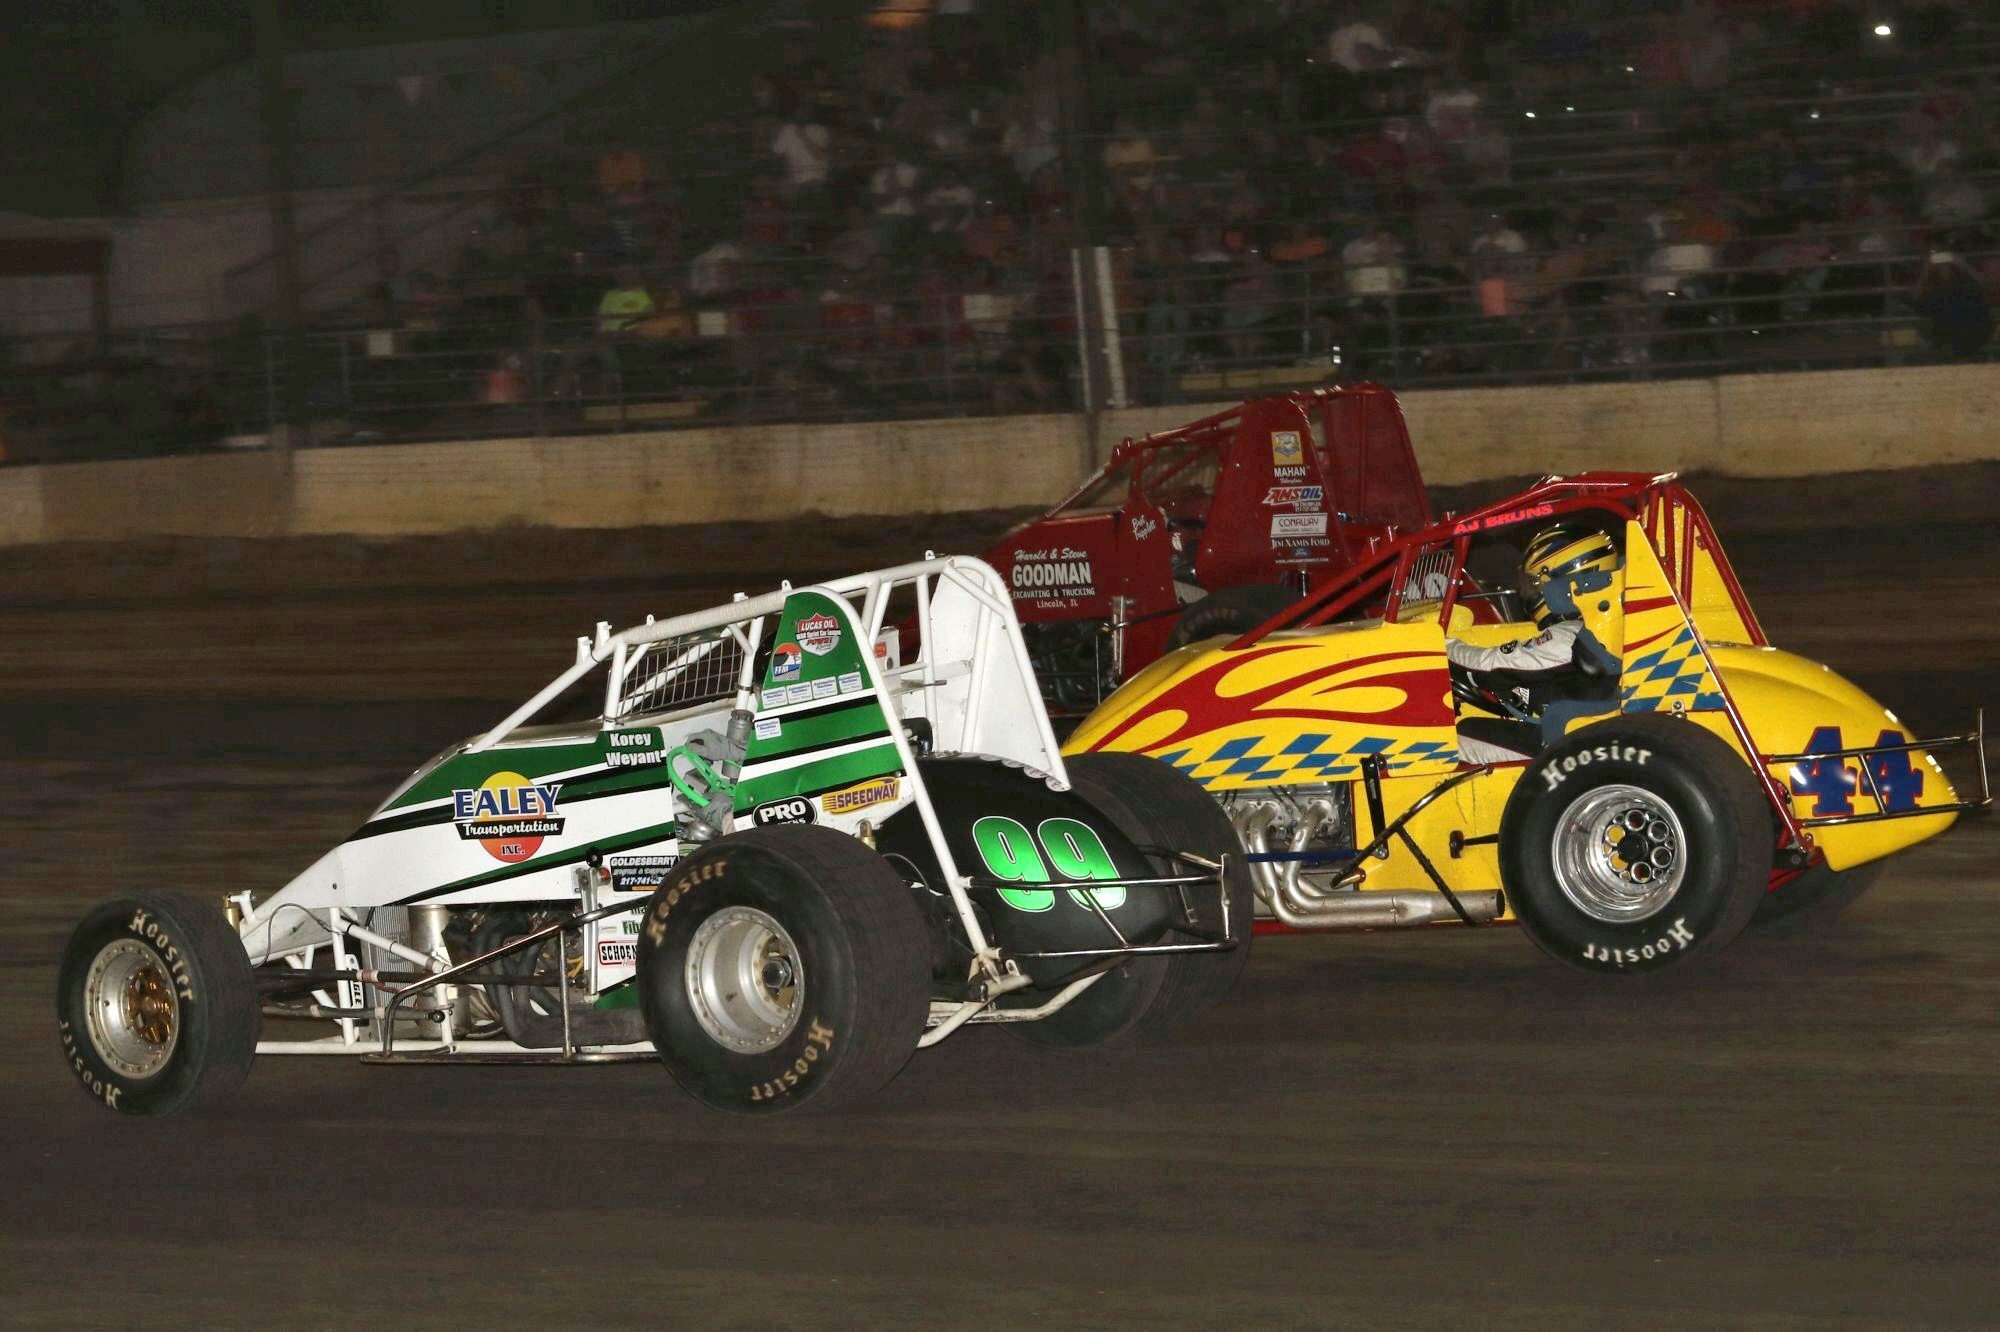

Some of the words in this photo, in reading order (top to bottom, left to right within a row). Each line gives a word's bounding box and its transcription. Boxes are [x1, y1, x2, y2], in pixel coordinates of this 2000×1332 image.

[1273, 466, 1306, 477] MAHAN
[1264, 487, 1322, 503] AMSOIL
[1279, 517, 1319, 527] CONAWAY
[1454, 520, 1479, 535] AJ
[1486, 504, 1553, 528] BRUNS
[1311, 537, 1330, 546] FORD
[1014, 549, 1047, 560] Harold
[1050, 548, 1057, 559] &
[1061, 548, 1087, 559] Steve
[1012, 562, 1092, 587] GOODMAN
[1062, 588, 1095, 597] TRUCKING
[1036, 600, 1066, 608] Lincoln,
[1070, 599, 1078, 607] IL
[801, 621, 822, 630] LUCAS
[823, 620, 834, 628] OIL
[609, 733, 651, 748] Korey
[606, 750, 661, 766] Weyant
[1540, 740, 1652, 791] Hoosier
[1789, 726, 1923, 817] 44
[452, 784, 563, 820] EALEY
[836, 783, 896, 808] SPEEDWAY
[759, 800, 806, 823] PRO
[463, 821, 559, 836] Transportation
[611, 856, 676, 868] GOLDESBERRY
[972, 816, 1126, 912] 99
[646, 860, 728, 948] Hoosier
[1583, 918, 1694, 968] Hoosier
[129, 908, 193, 1000] Hoosier
[751, 1016, 834, 1100] Hoosier
